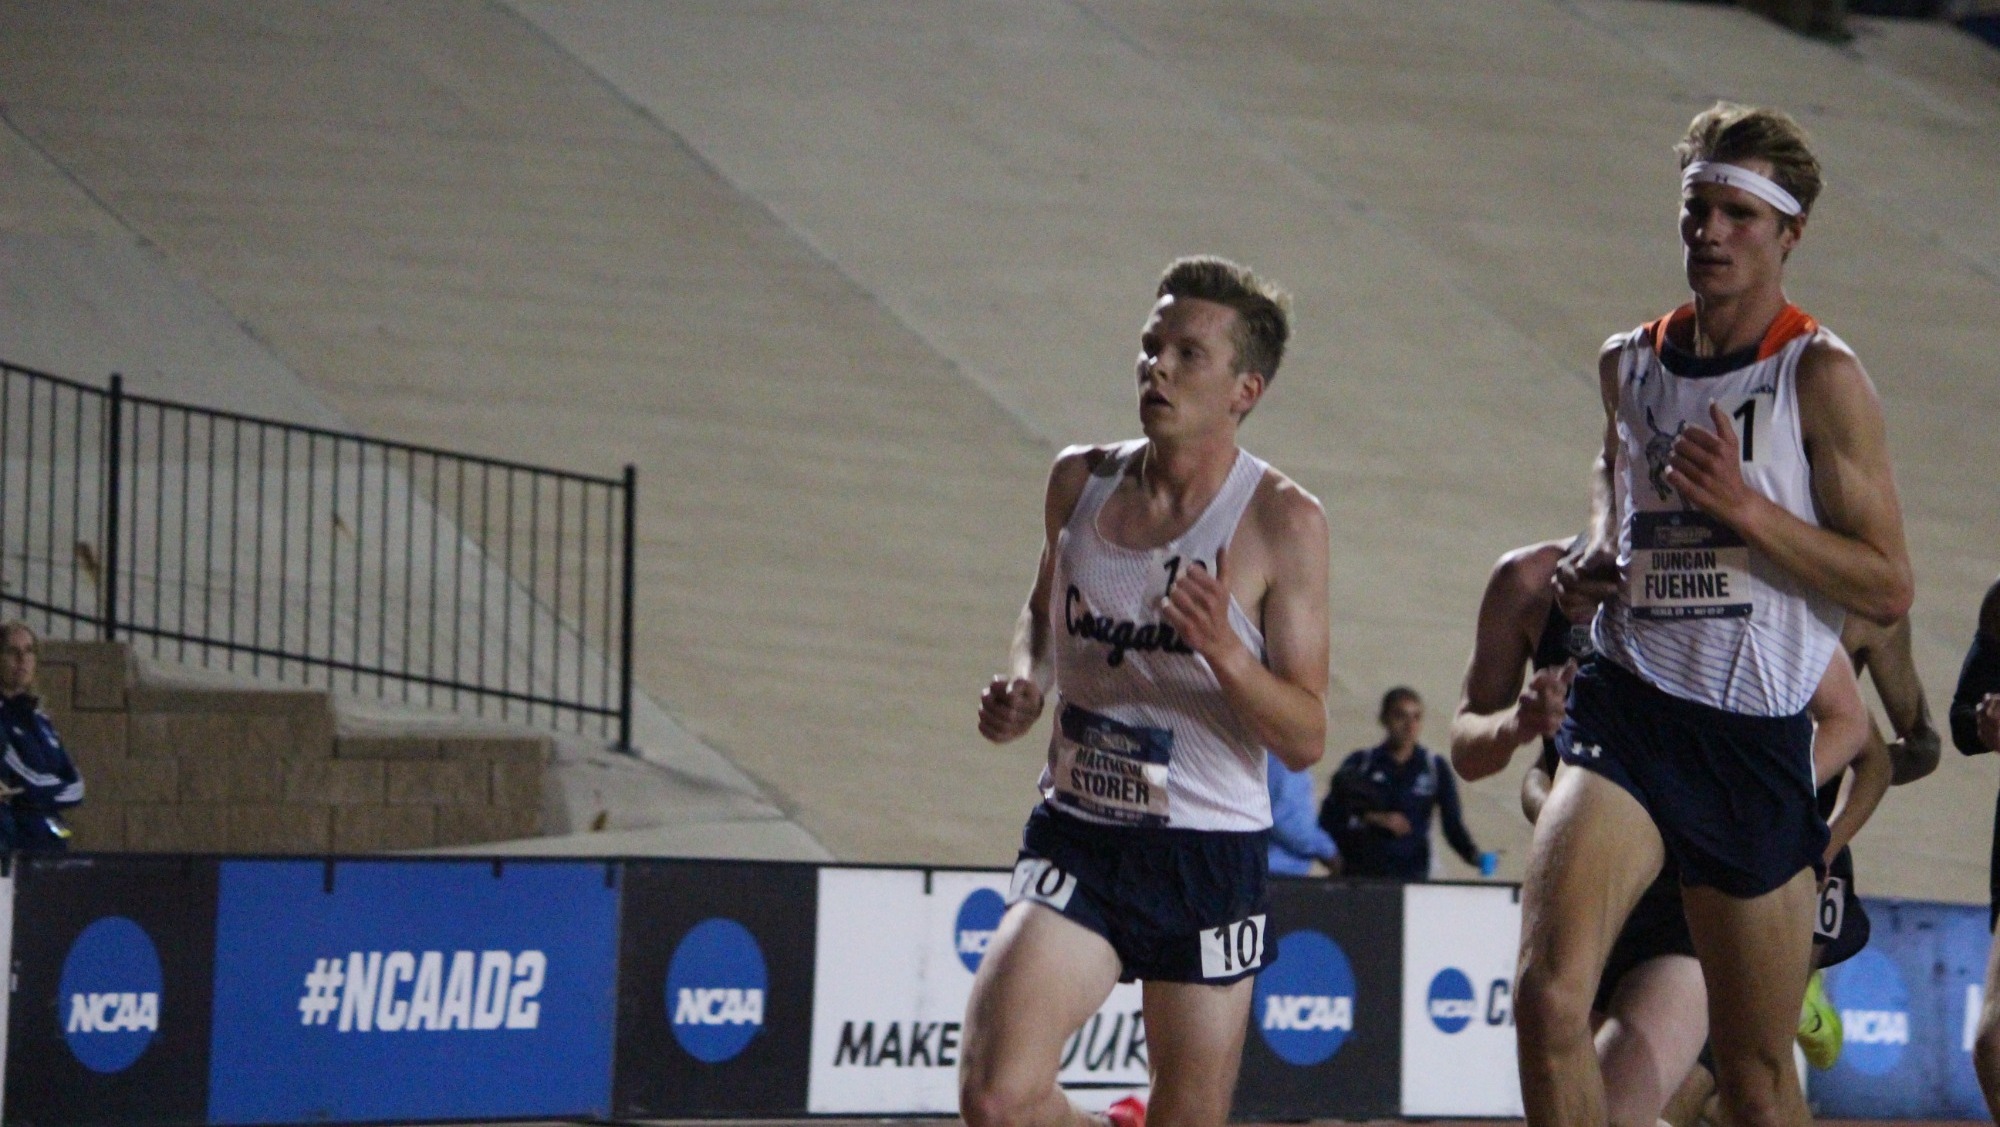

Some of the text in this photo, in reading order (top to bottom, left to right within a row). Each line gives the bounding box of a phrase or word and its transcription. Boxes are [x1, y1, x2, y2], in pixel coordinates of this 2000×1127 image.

[1733, 399, 1756, 463] 1
[1164, 556, 1208, 597] 1
[1651, 551, 1716, 570] DUNCAN
[1645, 573, 1730, 599] FUEHNE
[1071, 767, 1150, 805] STORER
[1214, 919, 1258, 971] 10
[299, 950, 546, 1032] #NCAAD2
[674, 988, 763, 1025] NCAA
[67, 992, 158, 1033] NCAA
[1263, 995, 1353, 1031] NCAA
[1842, 1010, 1908, 1045] NCAA
[834, 1021, 961, 1067] MAKE
